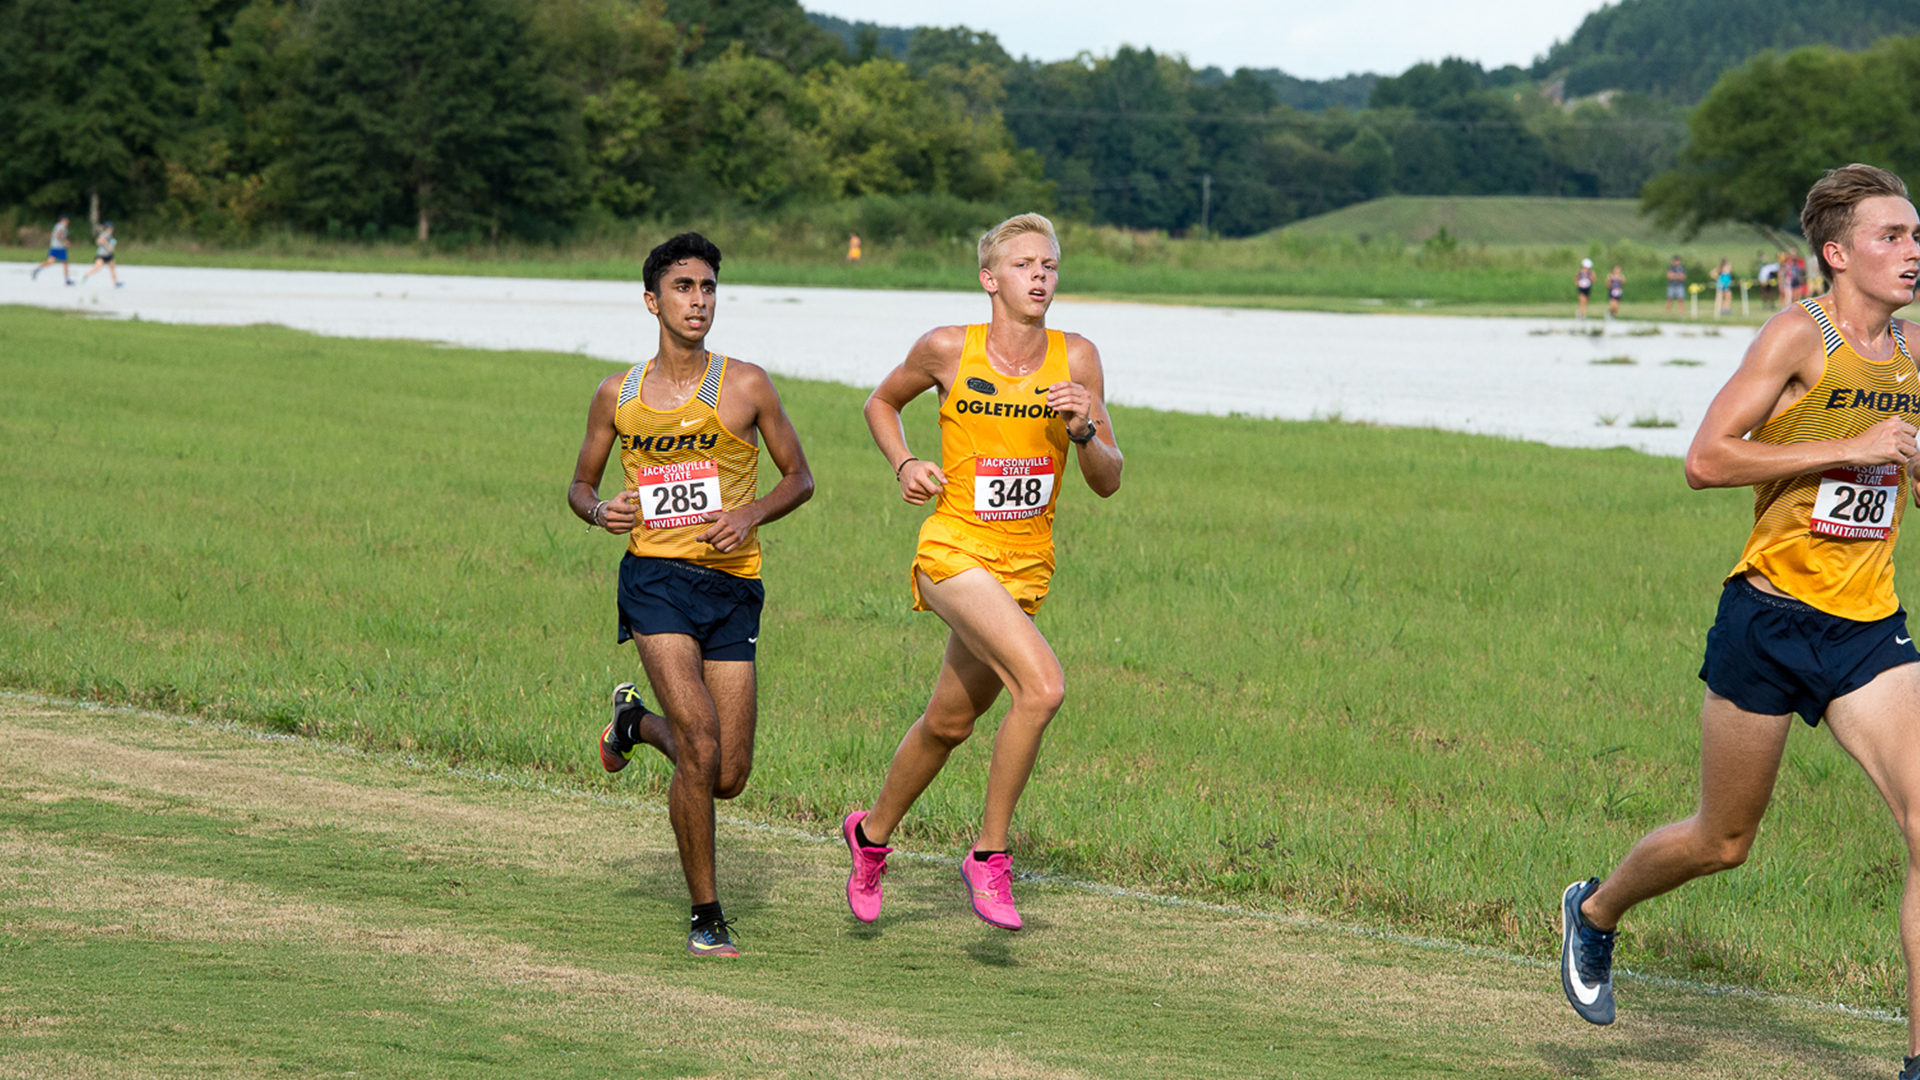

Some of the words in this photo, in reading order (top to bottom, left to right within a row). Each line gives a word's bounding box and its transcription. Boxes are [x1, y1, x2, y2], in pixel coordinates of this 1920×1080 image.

[956, 399, 1060, 419] OGLETHOR
[643, 461, 711, 476] JACKSONVILLE
[982, 456, 1049, 467] JACKSONVILLE
[663, 470, 692, 483] STATE
[1002, 466, 1031, 476] STATE
[1855, 473, 1884, 486] STATE
[652, 481, 708, 516] 285
[988, 477, 1042, 508] 348
[1828, 485, 1888, 524] 288
[649, 514, 706, 530] INVITATION
[980, 508, 1042, 521] INVITATIONAL
[1816, 520, 1885, 540] INVITATIONAL
